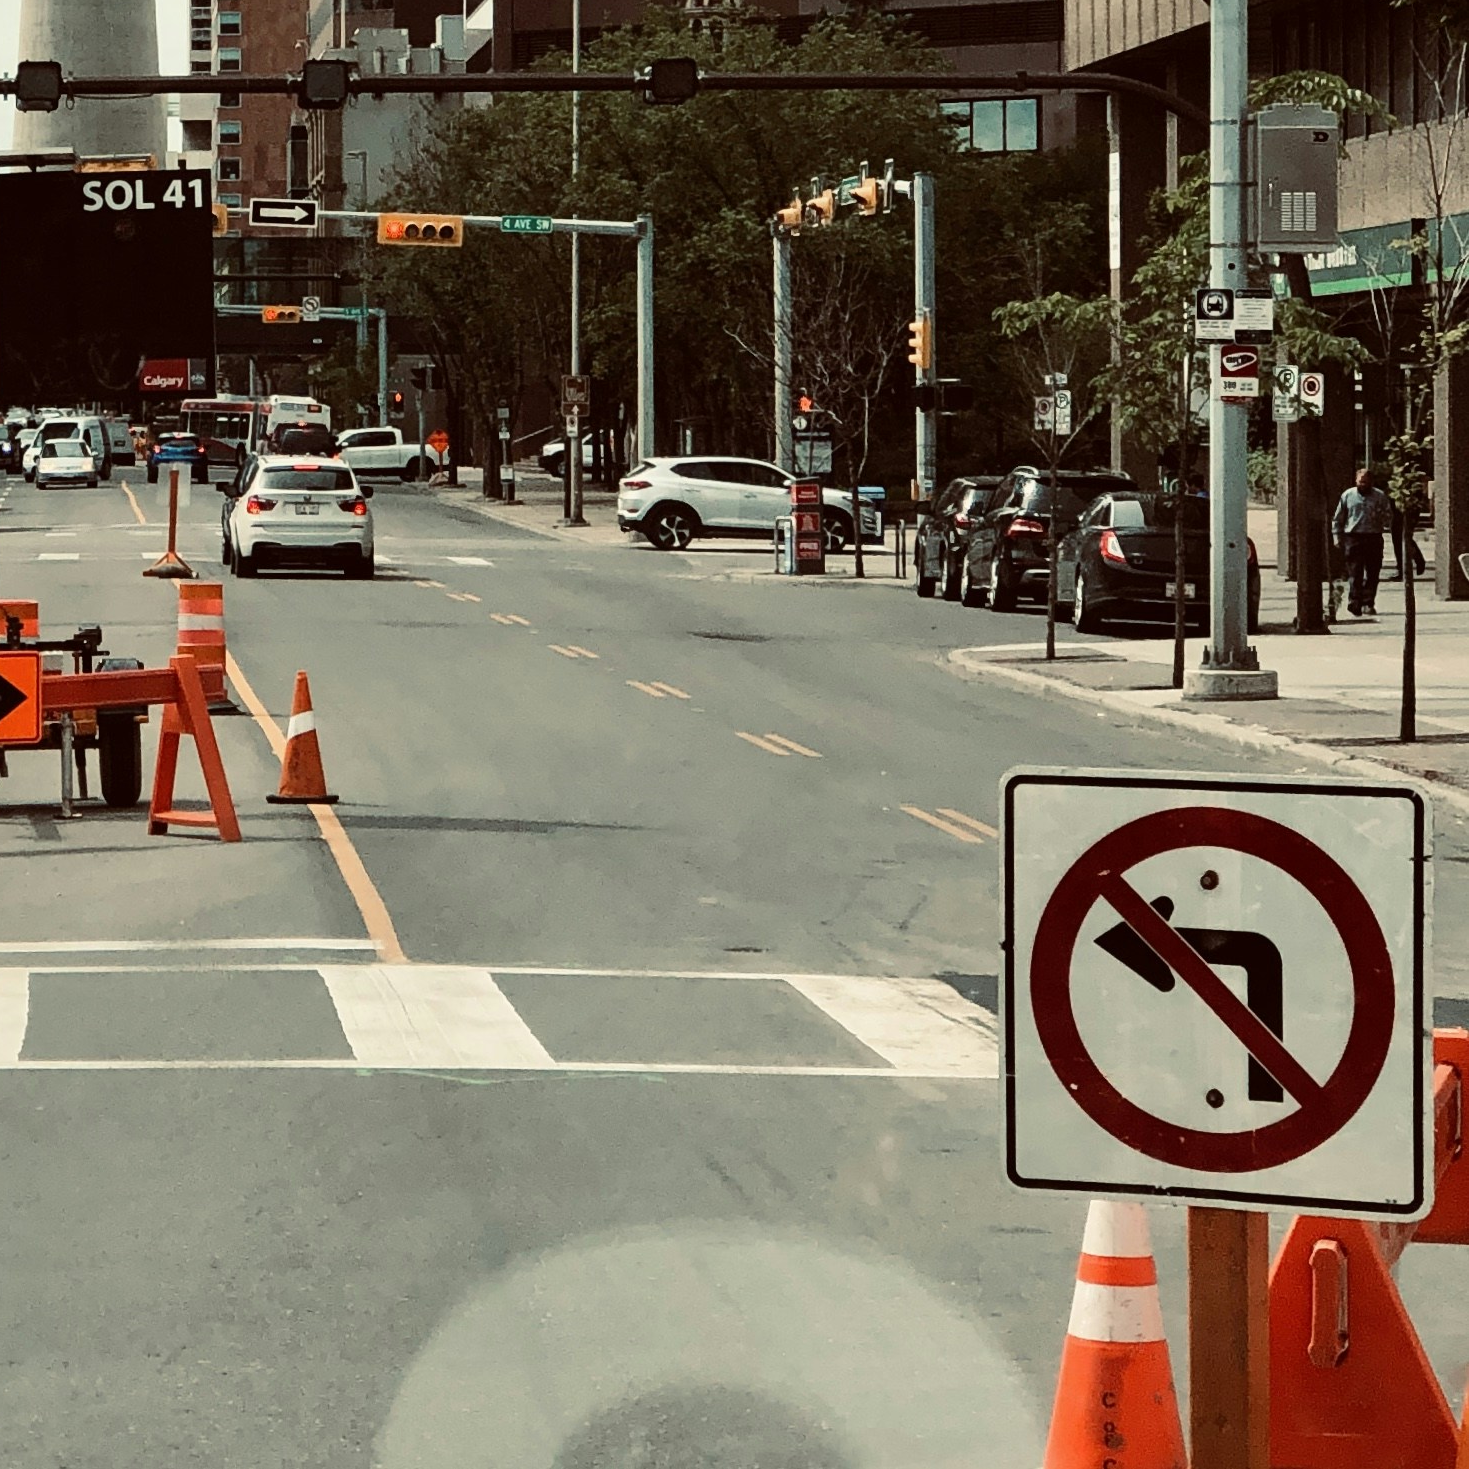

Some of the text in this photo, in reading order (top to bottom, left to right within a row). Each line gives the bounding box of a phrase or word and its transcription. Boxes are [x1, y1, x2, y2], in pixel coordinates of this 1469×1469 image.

[83, 178, 203, 212] SOL 41
[503, 218, 550, 230] 4 AVE SW
[143, 375, 184, 388] Calgary
